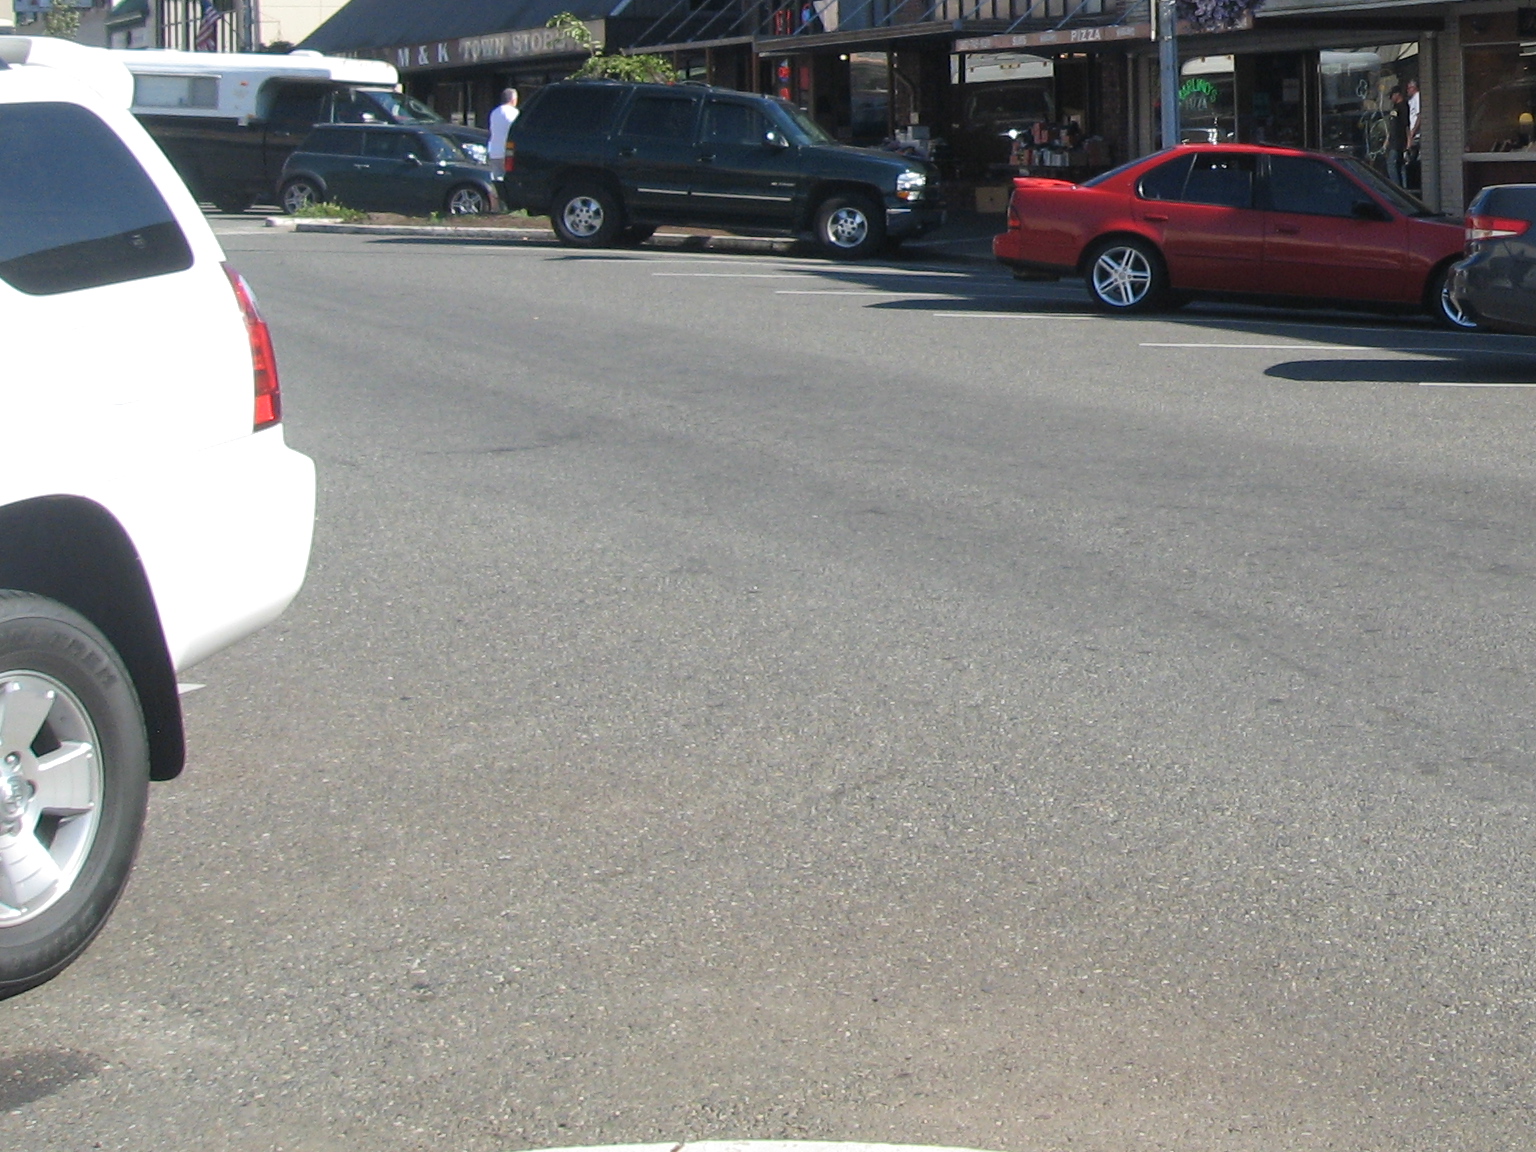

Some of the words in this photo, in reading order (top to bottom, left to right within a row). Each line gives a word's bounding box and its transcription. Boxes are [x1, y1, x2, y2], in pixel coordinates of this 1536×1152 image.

[1071, 29, 1101, 42] PIZZA
[397, 47, 409, 67] M
[418, 45, 429, 65] &
[438, 42, 449, 63] K
